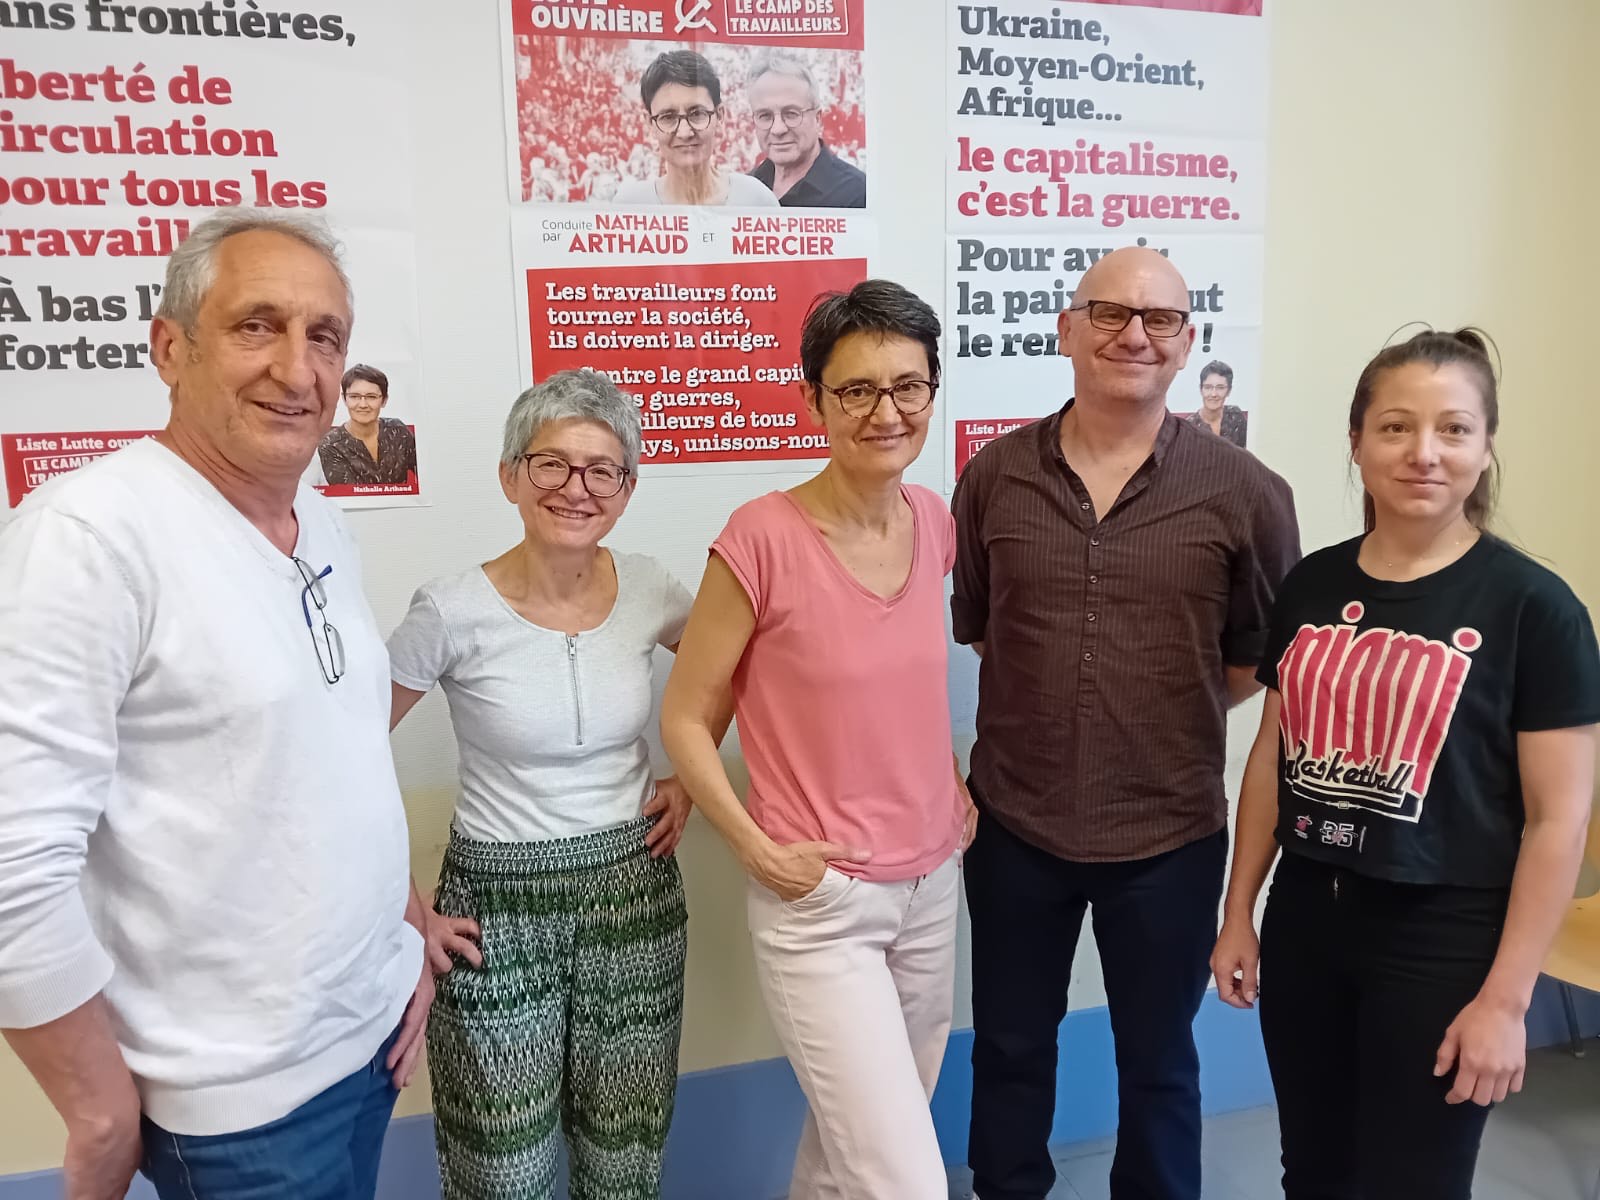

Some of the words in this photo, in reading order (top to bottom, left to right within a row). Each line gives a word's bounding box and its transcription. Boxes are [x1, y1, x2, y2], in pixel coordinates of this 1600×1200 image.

[531, 4, 664, 33] OUVRIÈRE
[735, 0, 753, 14] LE
[756, 0, 802, 14] CAMP
[805, 0, 834, 14] DES
[85, 0, 355, 47] frontières,
[730, 17, 842, 33] TRAVAILLEURS
[958, 6, 1110, 46] Ukraine,
[957, 46, 1204, 90] Moyen-Orient,
[0, 59, 156, 103] berté
[168, 65, 233, 105] de
[957, 86, 1122, 126] Afrique...
[957, 137, 994, 172] le
[1003, 138, 1238, 183] capitalisme,
[120, 170, 242, 208] tous
[251, 170, 327, 209] les
[957, 180, 1048, 217] c'est
[1057, 183, 1094, 217] la
[1102, 193, 1240, 227] guerre.
[542, 219, 593, 230] Conduite
[595, 214, 689, 232] NATHALIE
[731, 216, 847, 234] JEAN-PIERRE
[543, 233, 560, 243] par
[568, 233, 689, 254] ARTHAUD
[702, 233, 715, 242] ET
[732, 235, 834, 256] MERCIER
[957, 239, 1054, 272] Pour
[0, 275, 31, 322] À
[37, 285, 127, 322] bas
[546, 282, 587, 301] Les
[592, 282, 726, 302] travailleurs
[731, 282, 777, 301] font
[957, 281, 995, 315] la
[1003, 278, 1077, 323] pai
[547, 307, 637, 326] tourner
[641, 308, 663, 325] la
[668, 305, 751, 329] société,
[548, 331, 578, 349] ils
[583, 331, 670, 349] doivent
[674, 331, 695, 348] la
[700, 329, 779, 352] diriger.
[957, 325, 993, 358] le
[1202, 323, 1213, 353] !
[0, 334, 150, 371] forter
[660, 366, 681, 383] le
[686, 364, 751, 387] grand
[649, 391, 741, 411] guerres,
[640, 411, 715, 430] illeurs
[720, 411, 745, 428] de
[750, 411, 797, 427] tous
[966, 423, 994, 435] Liste
[16, 438, 58, 452] Liste
[61, 437, 105, 451] Lutte
[683, 432, 830, 452] unissons-nou
[33, 460, 48, 471] LE
